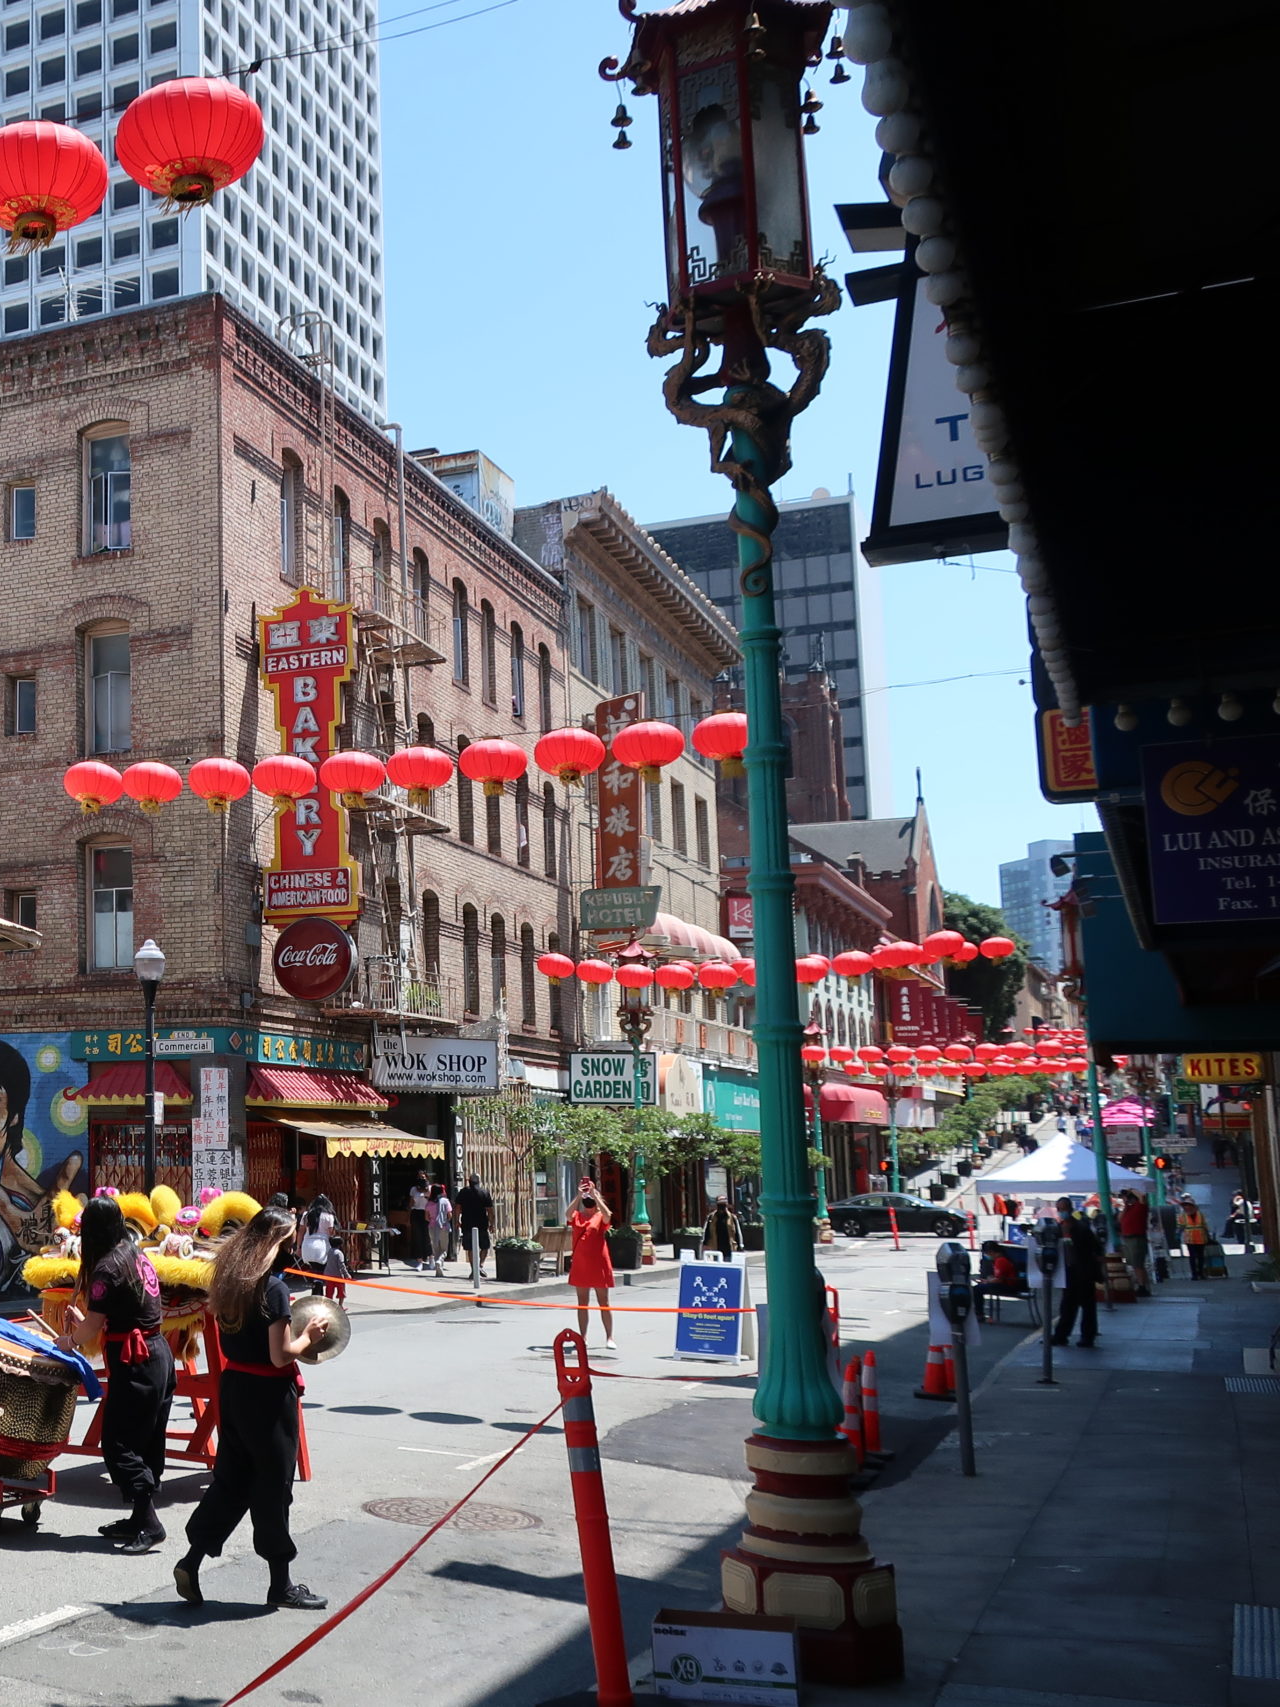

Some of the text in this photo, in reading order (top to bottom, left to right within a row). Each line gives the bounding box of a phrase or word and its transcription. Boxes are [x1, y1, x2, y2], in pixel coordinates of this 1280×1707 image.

[267, 648, 345, 672] EASTERN
[292, 676, 322, 857] BAKRY
[1162, 832, 1201, 851] LUI
[1207, 828, 1255, 848] AND
[269, 871, 347, 890] CHINESE &
[1222, 876, 1257, 889] Tel.
[321, 888, 348, 904] FOOD
[1218, 897, 1258, 910] Fax.
[587, 907, 646, 925] HOTEL
[158, 1043, 209, 1052] Commercial
[383, 1039, 398, 1050] the
[385, 1052, 488, 1072] WOK SHOP
[581, 1057, 626, 1076] SNOW
[1190, 1058, 1256, 1076] KITES
[387, 1071, 487, 1085] www.wokshop.com
[573, 1080, 631, 1099] GARDEN
